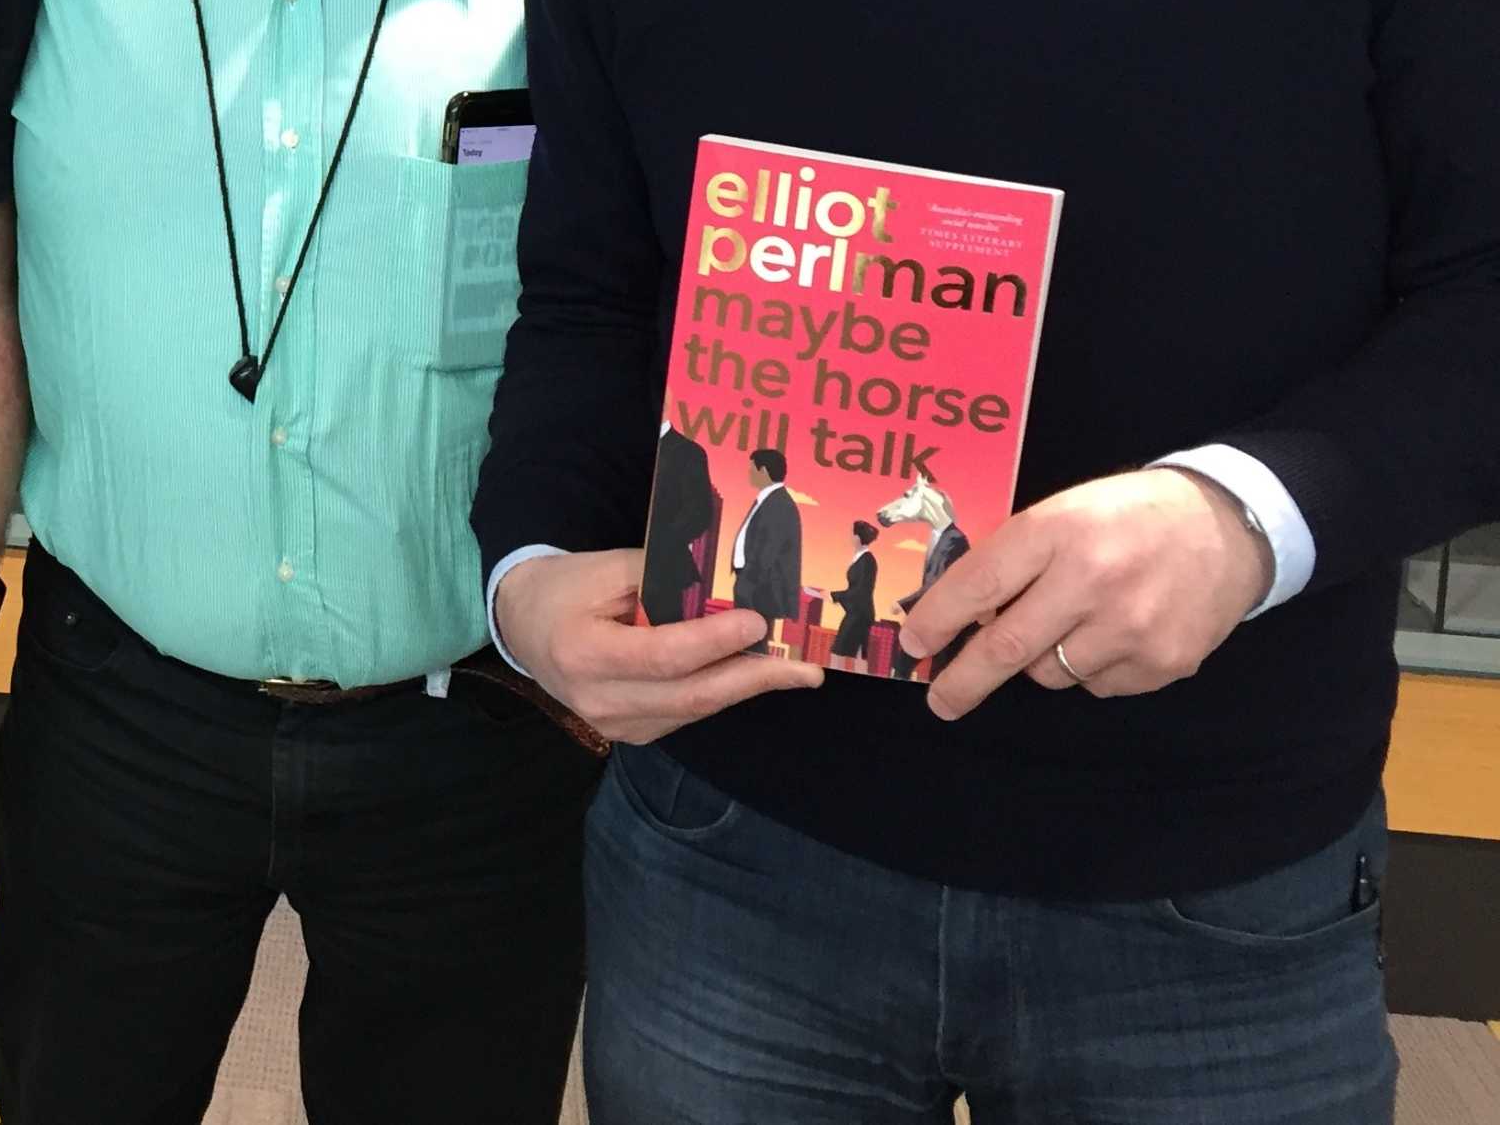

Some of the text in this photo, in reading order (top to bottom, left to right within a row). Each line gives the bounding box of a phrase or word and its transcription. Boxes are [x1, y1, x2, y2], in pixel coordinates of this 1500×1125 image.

[705, 166, 898, 244] elliot
[697, 224, 1028, 317] perlman
[691, 285, 931, 361] maybe
[684, 333, 1011, 433] the horse
[678, 397, 941, 484] will talk
